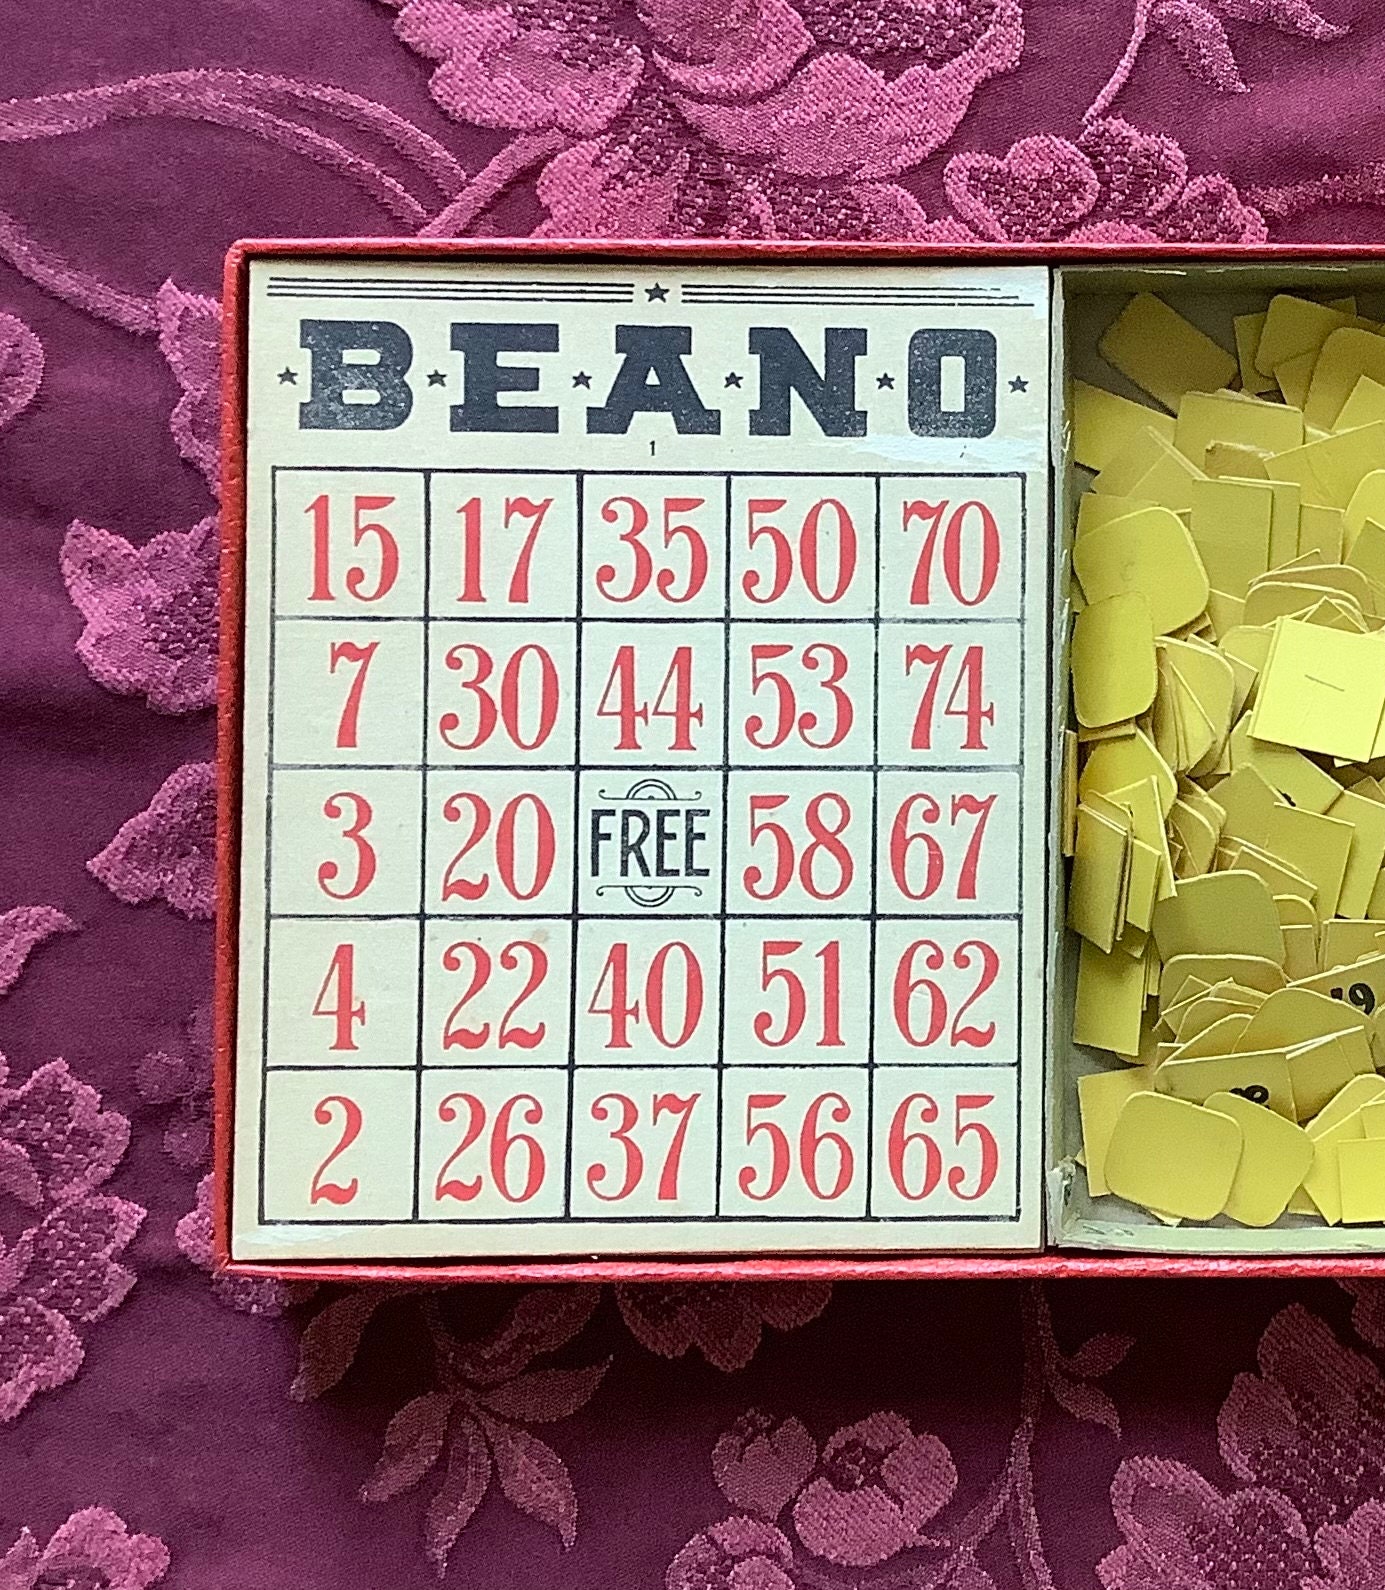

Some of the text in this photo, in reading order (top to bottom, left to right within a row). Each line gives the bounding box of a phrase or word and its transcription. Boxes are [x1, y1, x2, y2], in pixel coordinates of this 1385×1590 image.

[299, 319, 997, 438] BEANO
[648, 440, 657, 456] 1
[304, 494, 1001, 606] 15 17 35 50 70
[329, 641, 995, 751] 7 30 44 53 74
[317, 792, 997, 900] 3 20 FREE 58 67
[312, 940, 1000, 1050] 4 22 40 51 62
[309, 1092, 1000, 1205] 2 26 37 56 65
